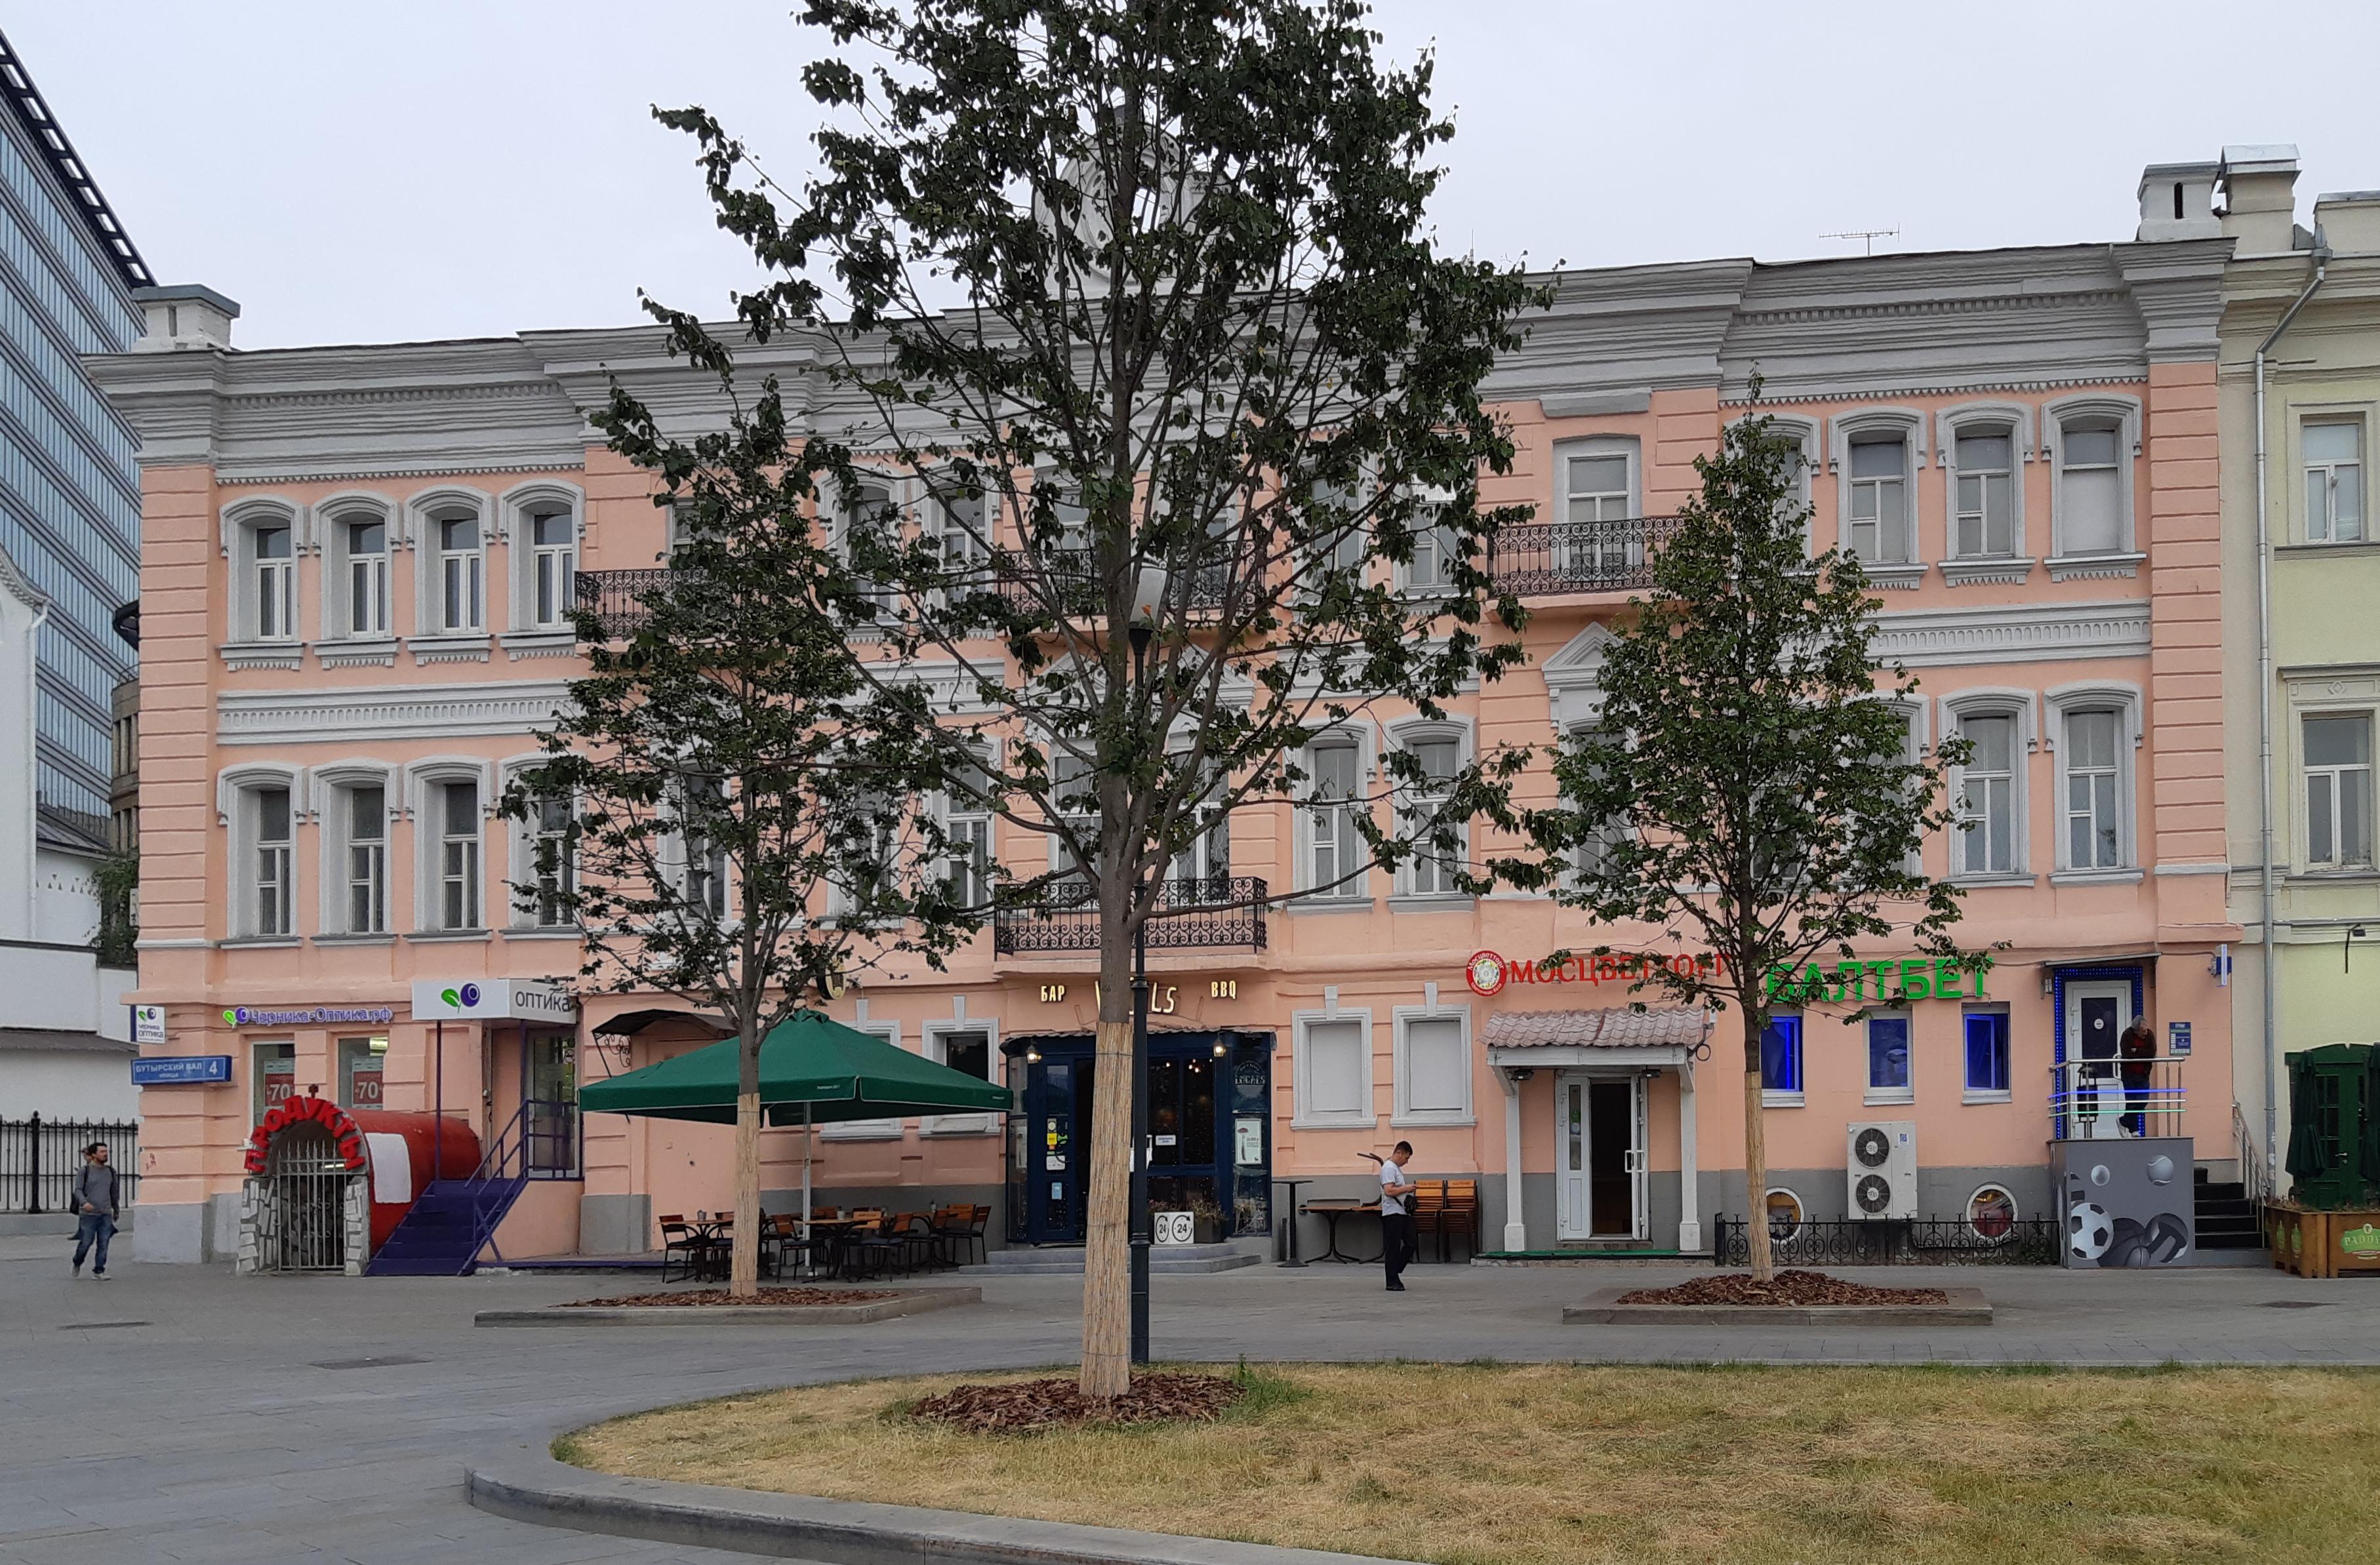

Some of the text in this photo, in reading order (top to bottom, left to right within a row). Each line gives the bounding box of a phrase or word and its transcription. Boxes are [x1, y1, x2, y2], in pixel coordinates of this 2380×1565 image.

[1041, 985, 1065, 1002] БАР
[1211, 980, 1237, 999] BBQ
[136, 1063, 184, 1073] БУТЫРСКИЙ
[209, 1061, 218, 1075] 4
[244, 1095, 365, 1173] ПРОДУКТЫ
[1159, 1224, 1167, 1234] 24
[1177, 1223, 1188, 1233] 24
